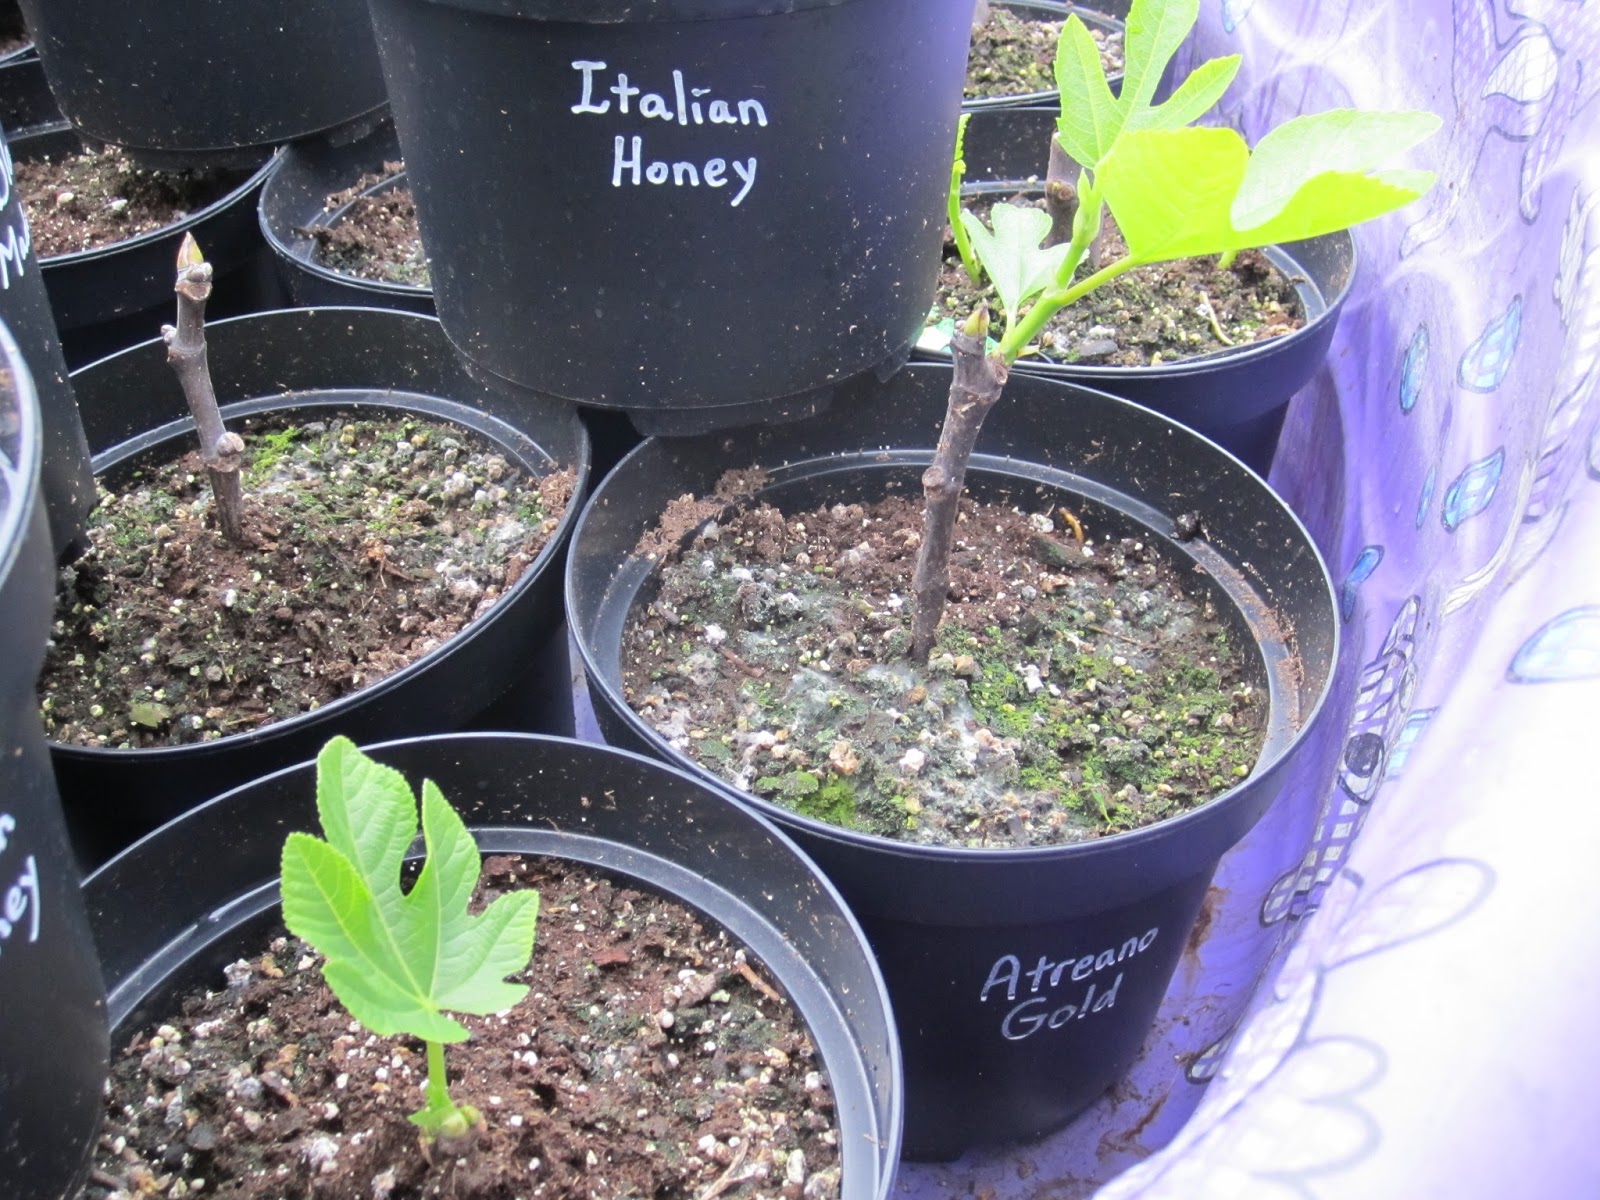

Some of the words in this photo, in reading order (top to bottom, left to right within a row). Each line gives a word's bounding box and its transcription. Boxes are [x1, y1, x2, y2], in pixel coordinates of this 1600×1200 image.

[570, 60, 768, 127] Italian
[612, 135, 758, 207] Honey
[980, 927, 1159, 1002] Atreano
[1001, 972, 1124, 1040] Gold
